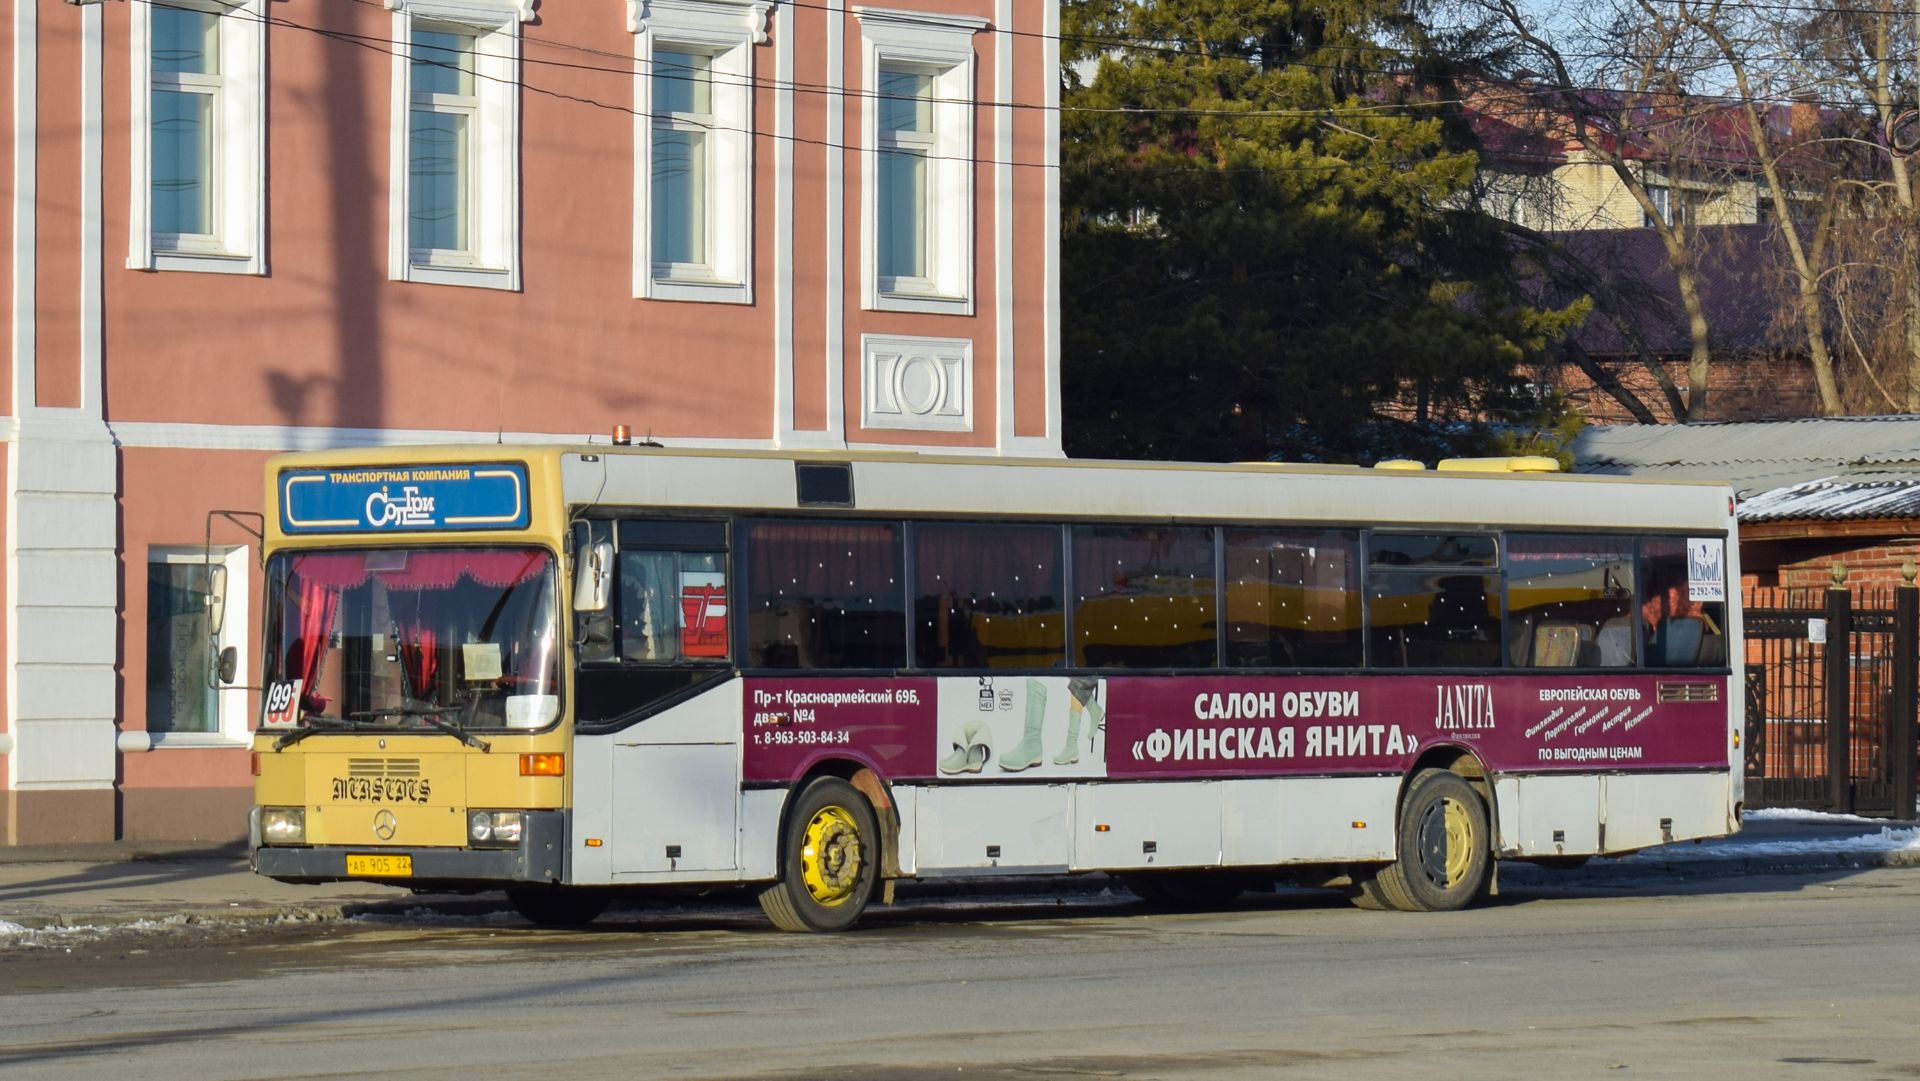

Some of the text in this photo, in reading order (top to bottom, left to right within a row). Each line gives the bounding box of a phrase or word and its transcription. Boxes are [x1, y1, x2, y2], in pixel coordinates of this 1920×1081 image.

[330, 469, 470, 483] ТРАНСПОРТНАЯ КОМПАНИЯ
[754, 689, 920, 708] Пр-т Красноармейский 69Б,
[1194, 691, 1359, 719] САЛОН ОБУВИ
[1539, 686, 1641, 700] ЕВРОПЕЙСКАЯ ОБУВЬ
[793, 709, 815, 723] №4
[1435, 684, 1496, 729] JANITA
[1602, 705, 1632, 732] Австрия
[1624, 705, 1653, 731] Испания
[1525, 706, 1564, 738] Финляндия
[1544, 706, 1587, 741] Португалия
[1574, 706, 1609, 736] Германия
[754, 731, 850, 744] т. 8-963-503-84-34
[1131, 724, 1419, 762] «ФИНСКАЯ ЯНИТА»
[1538, 747, 1642, 761] ПО ВЫГОДНЫМ ЦЕНАМ
